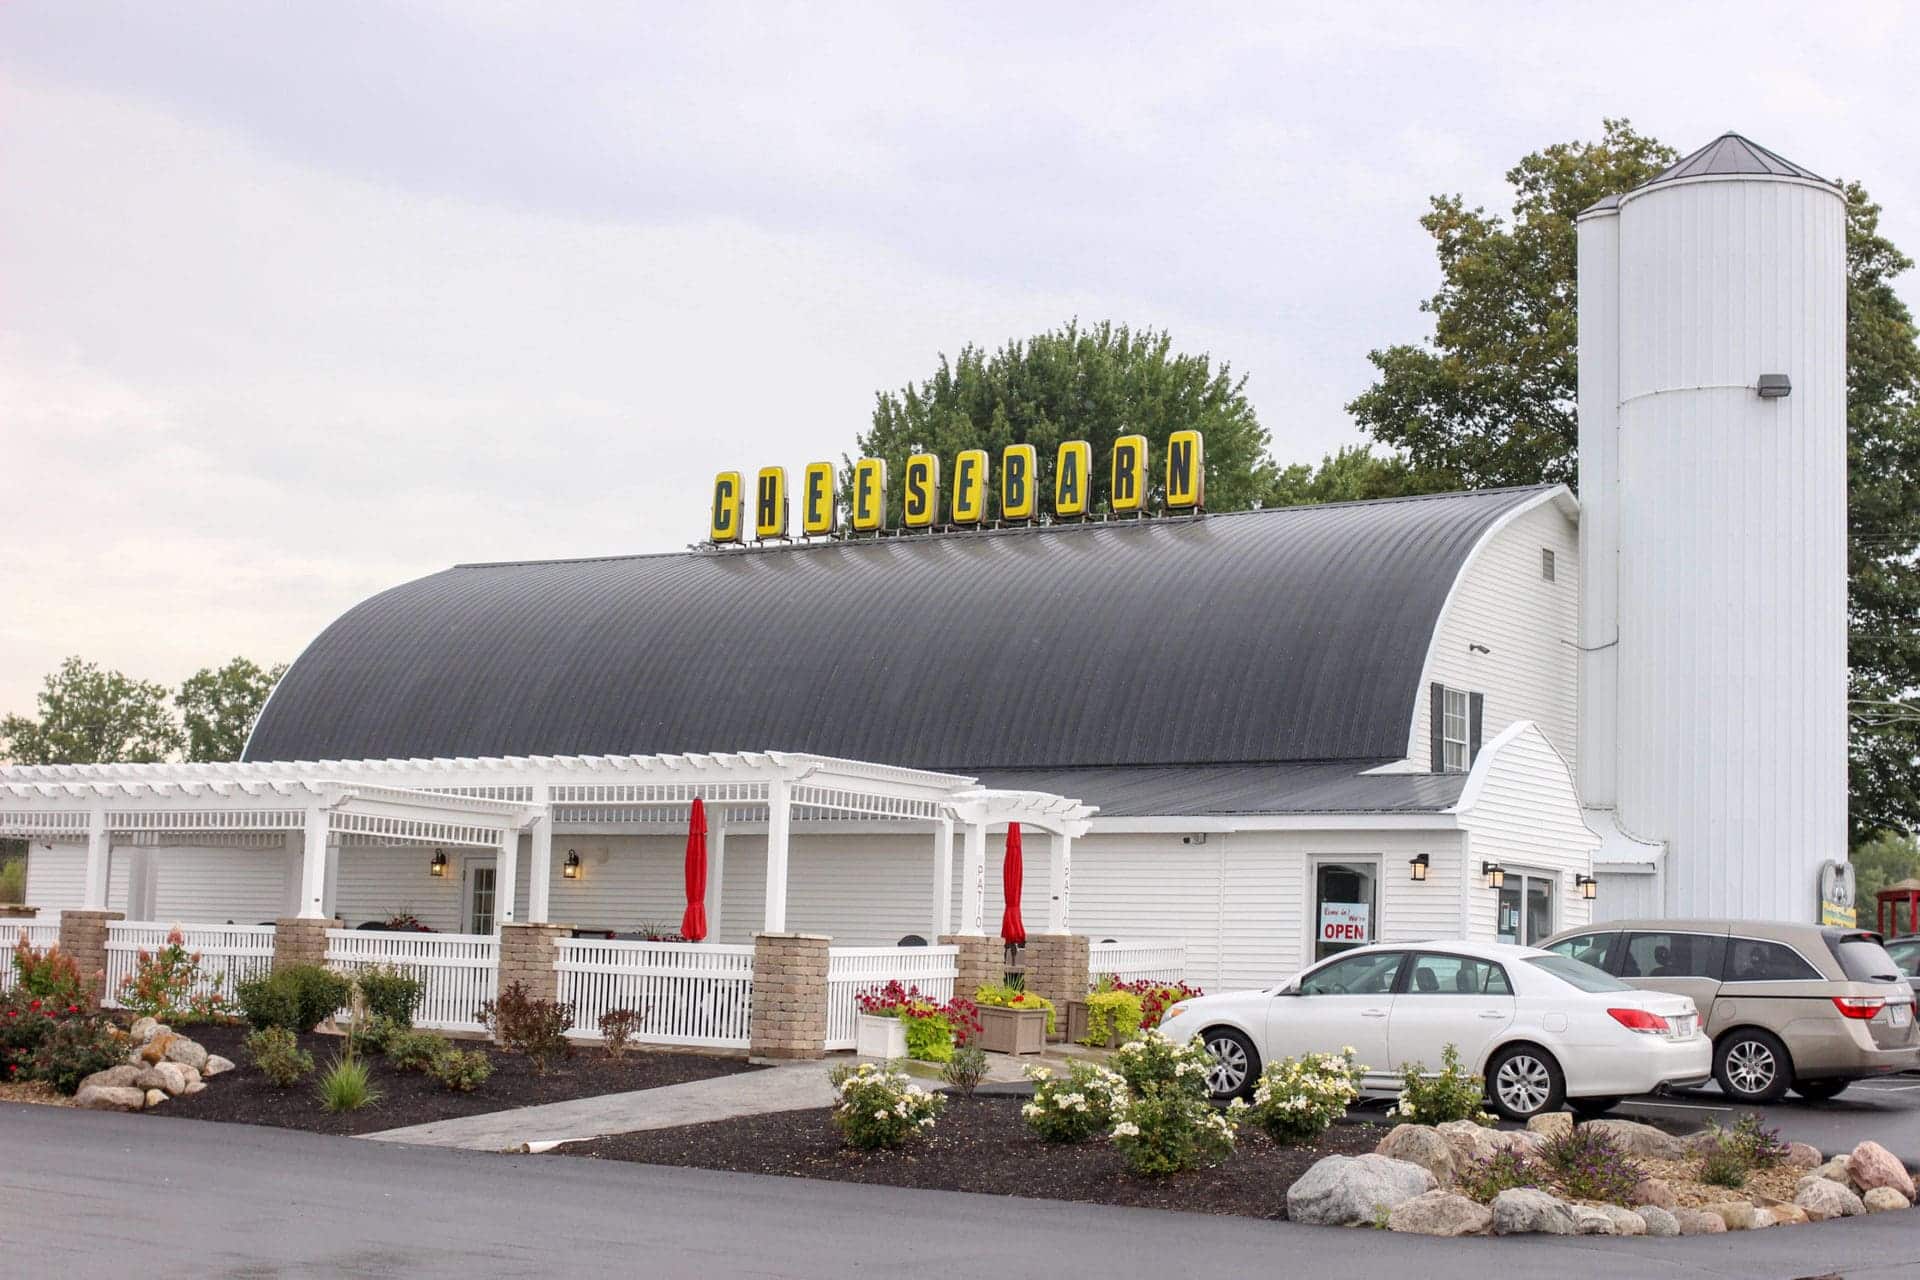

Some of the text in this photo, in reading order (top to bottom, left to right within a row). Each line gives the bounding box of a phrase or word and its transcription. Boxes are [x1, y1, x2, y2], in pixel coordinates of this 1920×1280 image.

[713, 440, 1191, 531] CHEESEBARN
[975, 864, 984, 929] PATIO
[1324, 923, 1364, 939] OPEN
